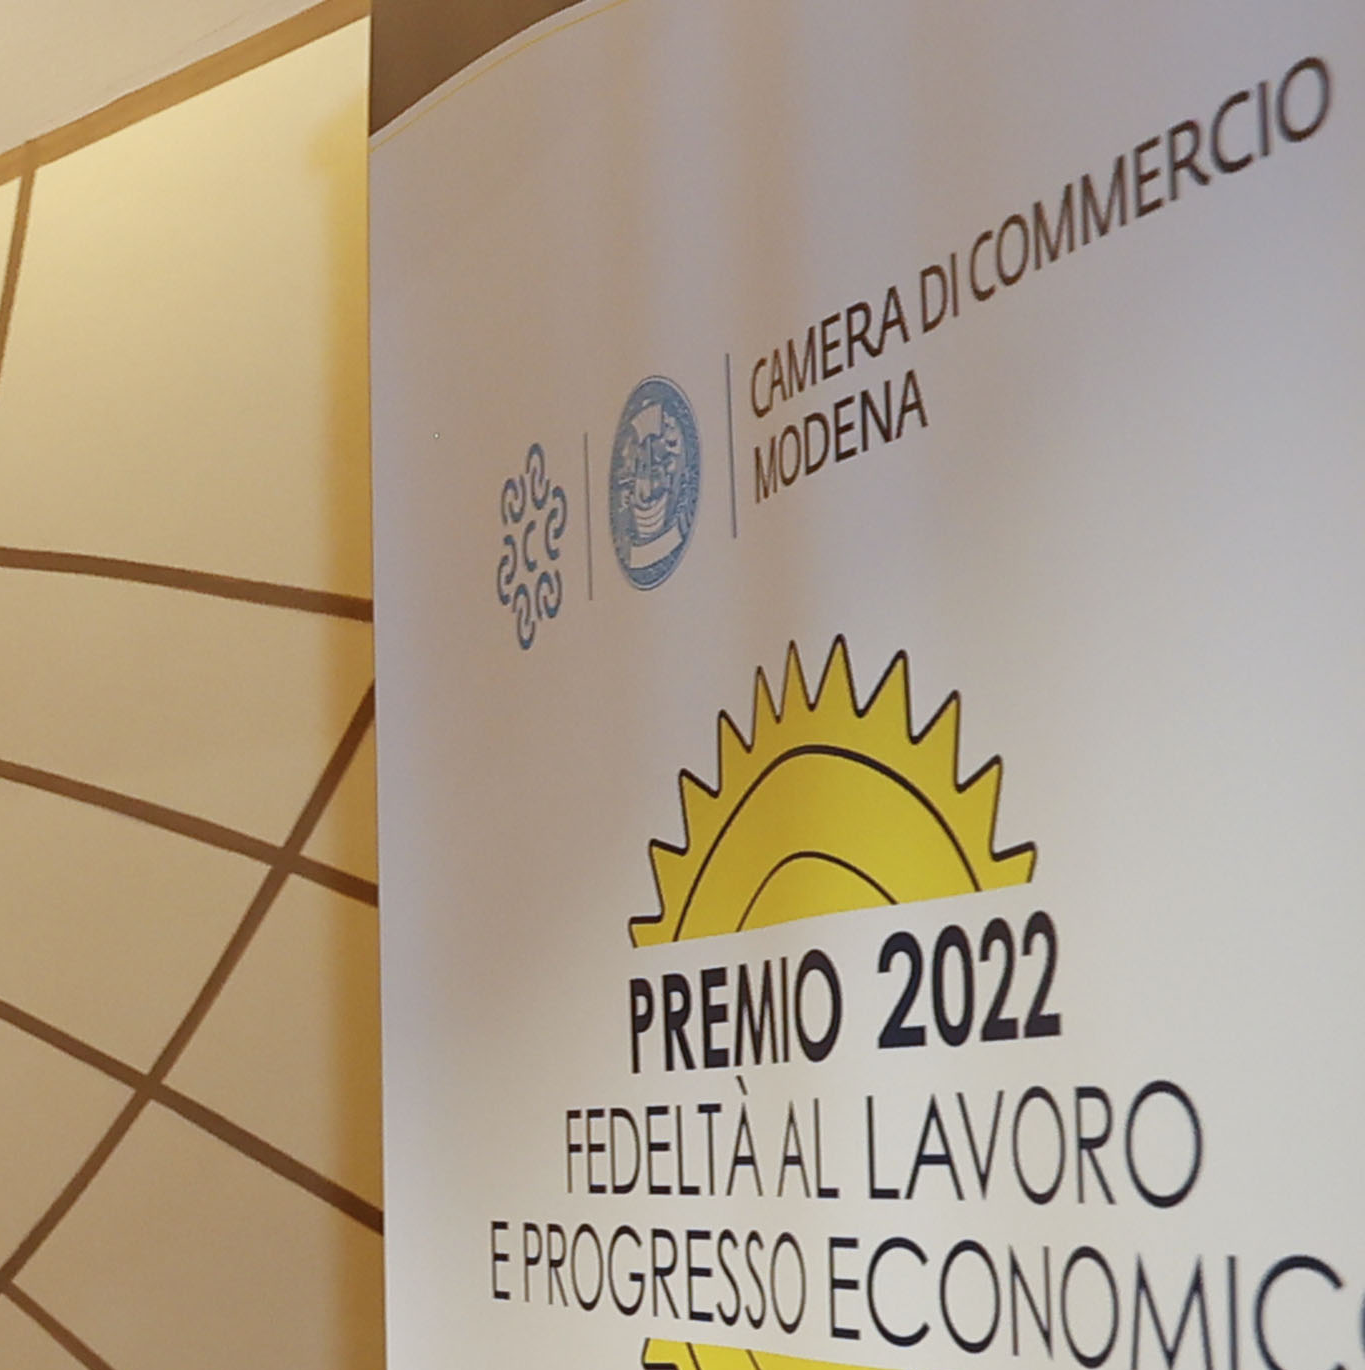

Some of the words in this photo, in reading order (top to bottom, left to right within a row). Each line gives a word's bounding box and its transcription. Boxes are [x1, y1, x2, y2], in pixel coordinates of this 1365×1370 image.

[751, 285, 911, 420] CAMERA
[919, 251, 960, 335] DI
[968, 55, 1332, 303] COMMERCIO
[753, 369, 930, 504] MODENA
[629, 948, 843, 1075] PREMIO
[876, 910, 1062, 1050] 2022
[565, 1075, 765, 1197] FEDELTÀ
[777, 1097, 840, 1199] AL
[865, 1079, 1204, 1210] LAVORO
[490, 1220, 511, 1301] E
[522, 1222, 807, 1335] PROGRESSO
